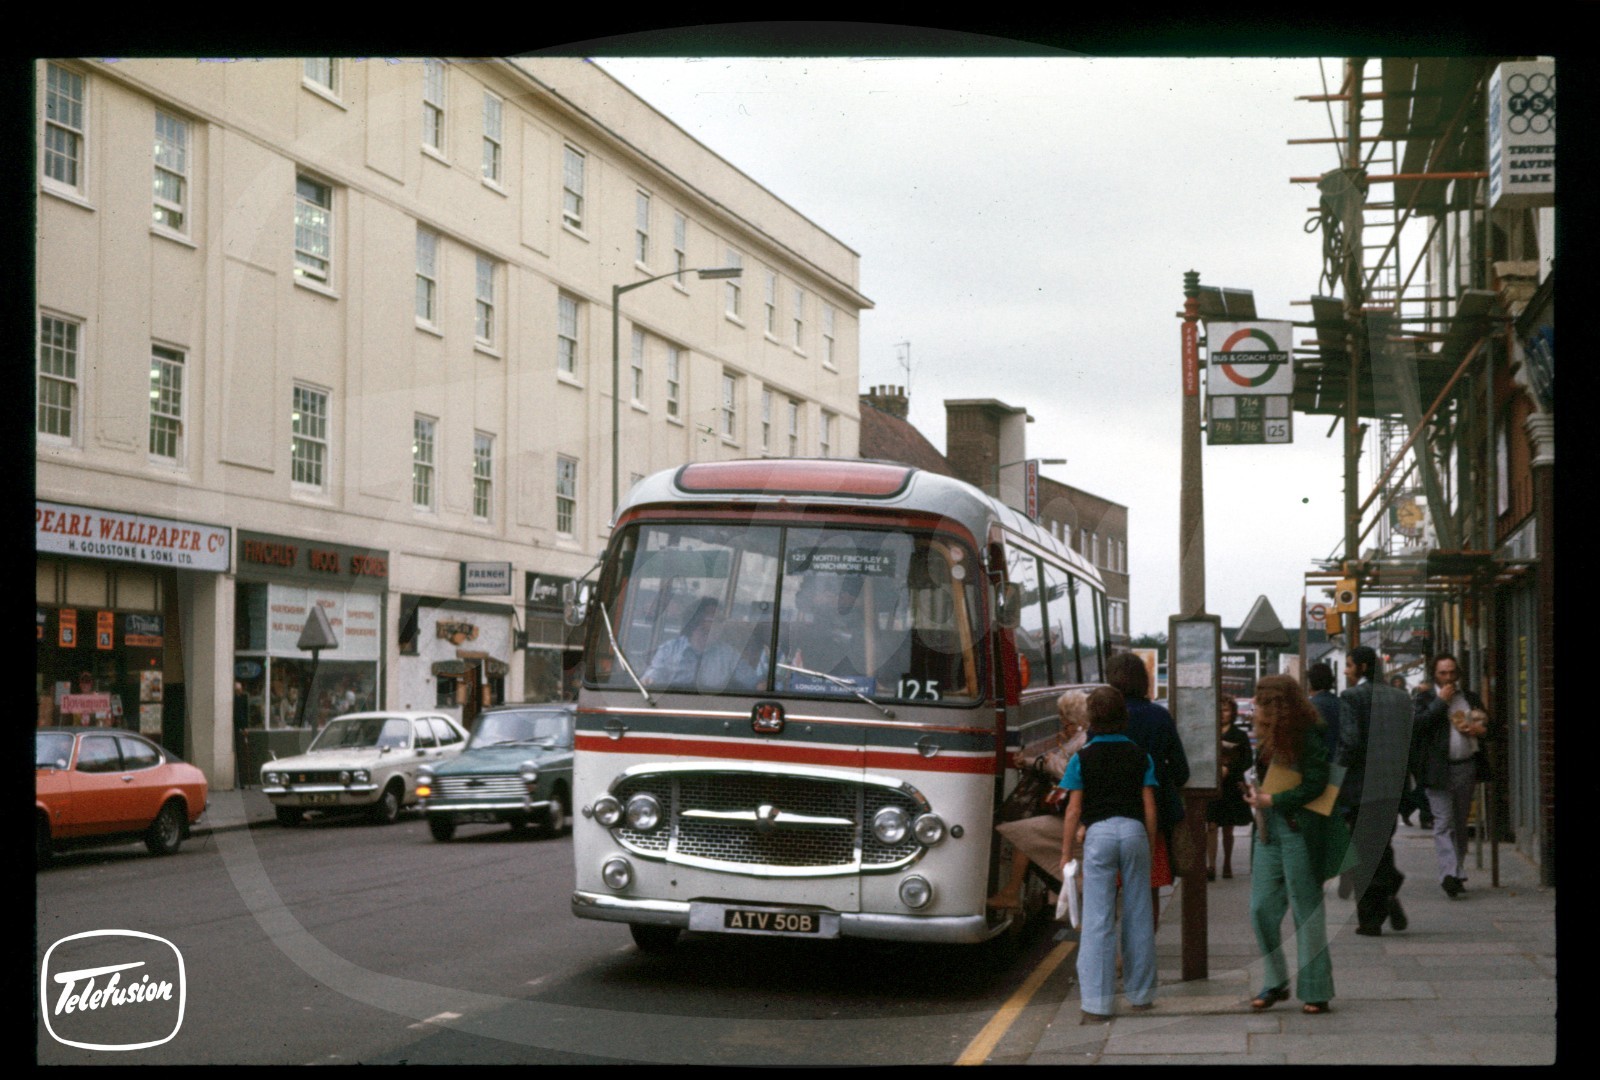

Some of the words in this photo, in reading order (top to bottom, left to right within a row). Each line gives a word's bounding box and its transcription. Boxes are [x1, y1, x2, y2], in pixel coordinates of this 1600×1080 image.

[1509, 174, 1551, 184] BANK
[1213, 354, 1228, 362] BUS
[1237, 353, 1266, 362] COACH
[1268, 353, 1287, 361] STOP
[1241, 397, 1259, 407] 714
[1216, 421, 1232, 431] 716
[1267, 425, 1286, 437] 125
[36, 510, 92, 538] PEARL
[100, 518, 201, 551] WALLPAPER
[69, 541, 78, 550] H.
[81, 543, 136, 558] GOLDSTONE
[141, 550, 147, 559] &
[151, 551, 173, 562] SONS
[178, 554, 193, 564] LTD.
[244, 540, 298, 566] FINCHLEY
[310, 550, 341, 572] WOOL
[843, 555, 881, 563] FINCHLEY
[469, 570, 505, 579] FRENCH
[795, 684, 825, 692] LONDON
[897, 679, 939, 701] 125
[731, 911, 769, 929] ATV
[774, 914, 812, 931] 50B
